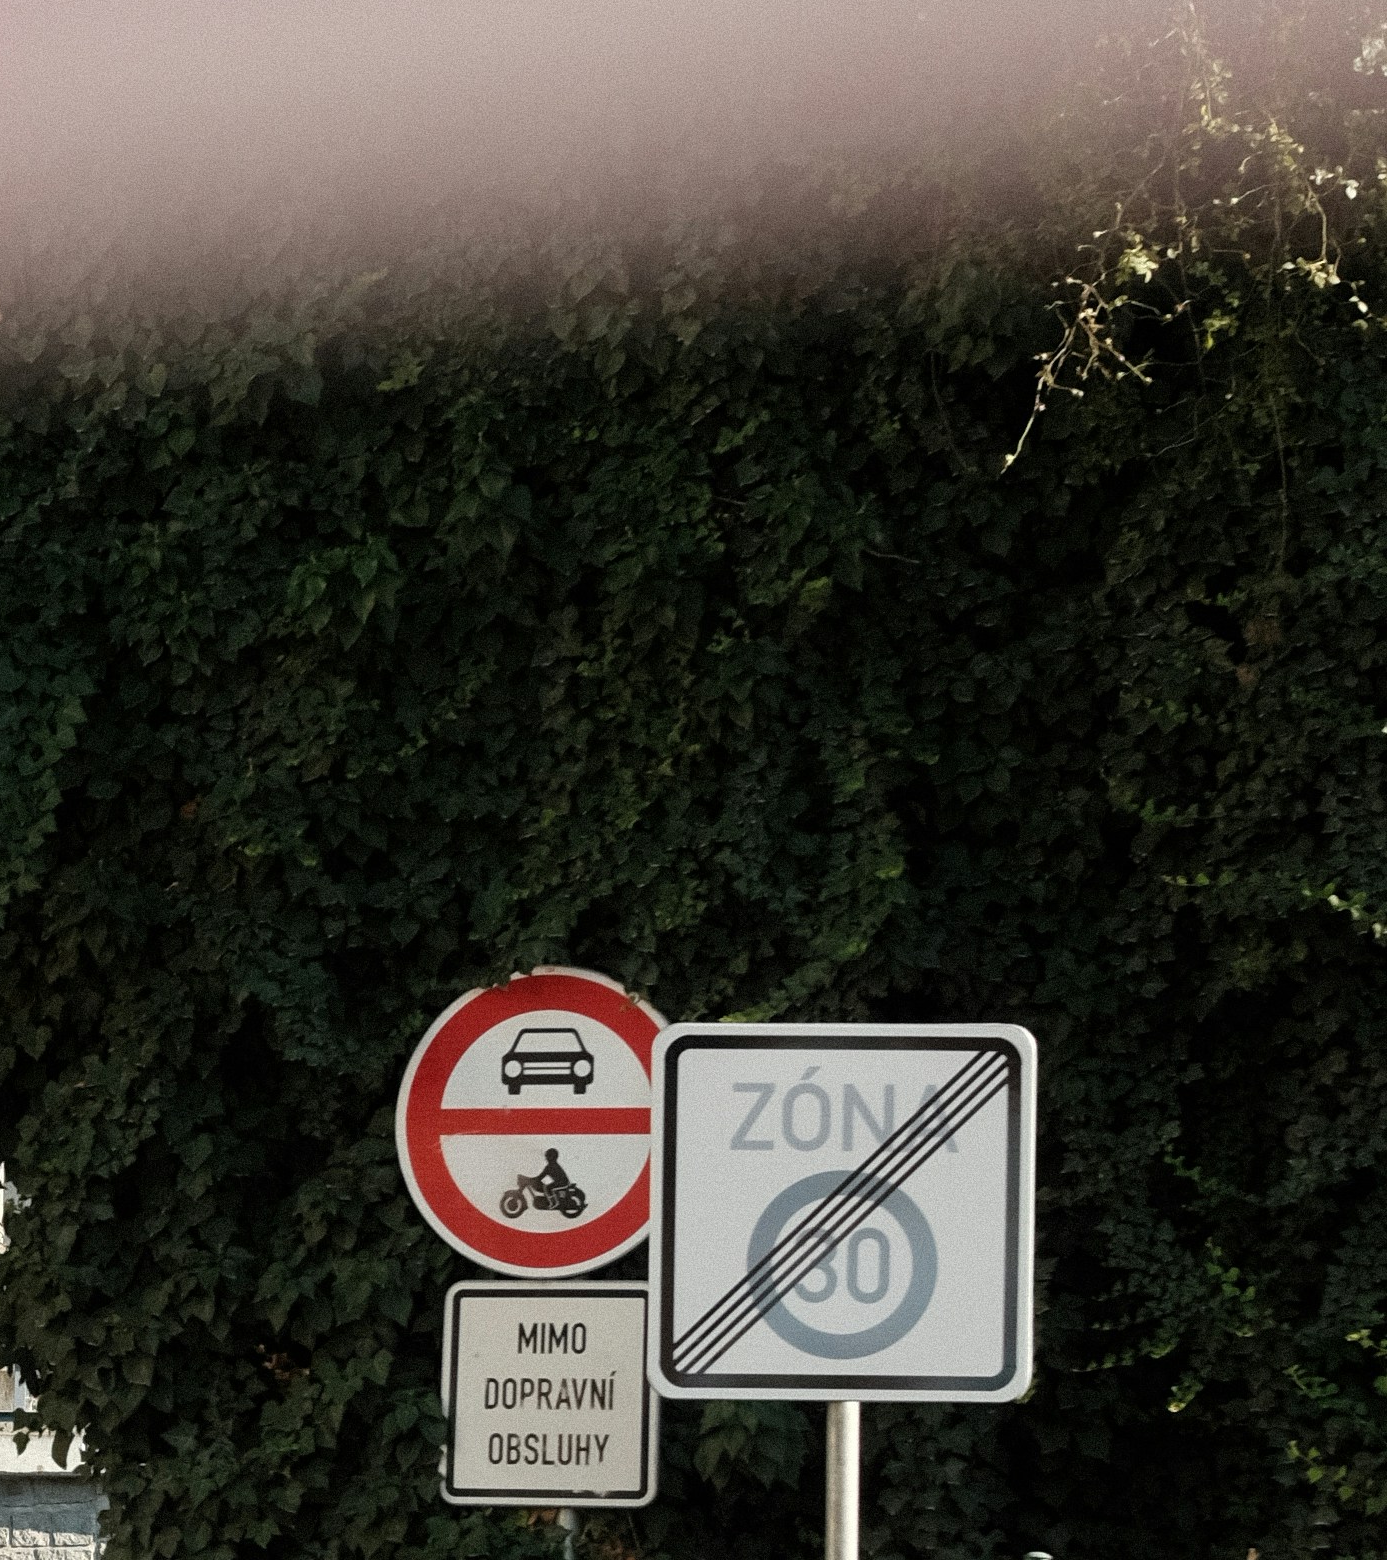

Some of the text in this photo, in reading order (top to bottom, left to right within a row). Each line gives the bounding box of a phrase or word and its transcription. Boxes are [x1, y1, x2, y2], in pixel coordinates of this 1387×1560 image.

[730, 1065, 960, 1153] ZÓNA
[793, 1226, 890, 1305] 30
[517, 1322, 587, 1355] MIMO
[484, 1370, 617, 1411] DOPRAVNÍ
[488, 1432, 610, 1466] OBSLUHY
